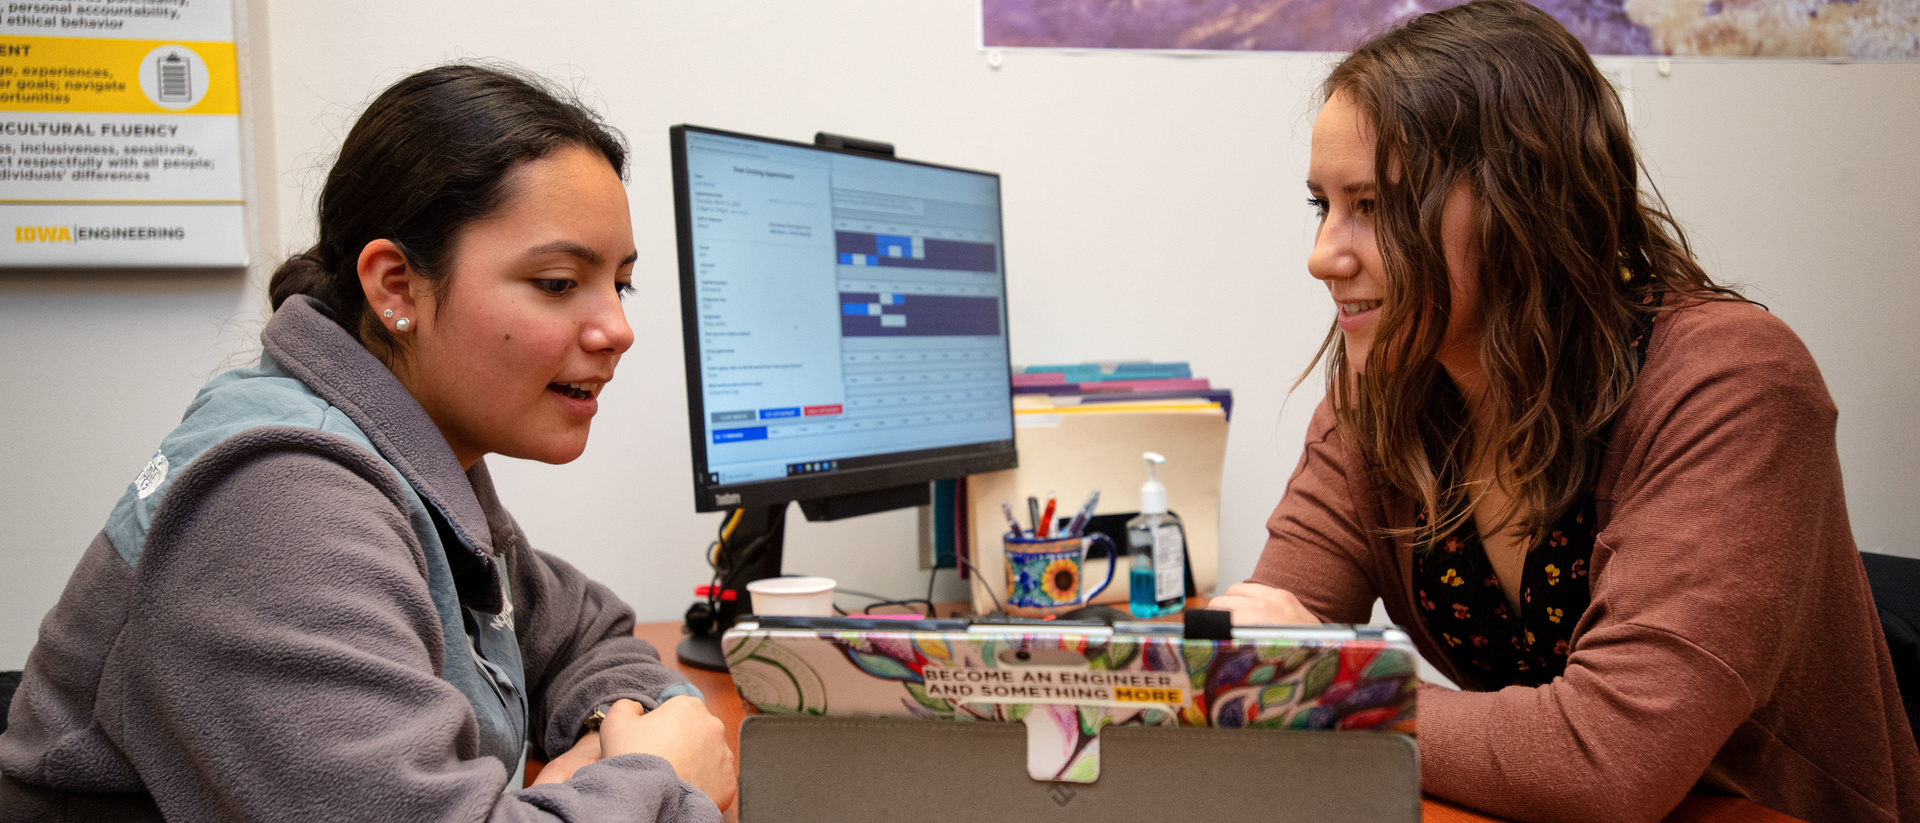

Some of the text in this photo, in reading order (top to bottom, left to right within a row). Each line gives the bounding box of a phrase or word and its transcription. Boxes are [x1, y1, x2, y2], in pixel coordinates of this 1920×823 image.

[9, 3, 181, 20] personal accountability,
[7, 14, 124, 30] ethical behavior
[0, 44, 31, 57] ENT
[22, 66, 113, 79] experiences,
[65, 80, 126, 93] navigate
[101, 123, 178, 138] FLUENCY
[21, 142, 119, 156] inclusiveness,
[123, 143, 197, 158] sensitivity,
[18, 157, 103, 171] respectfully
[108, 158, 138, 169] with
[142, 158, 158, 169] all
[72, 169, 150, 182] differences
[15, 226, 185, 243] IOWA ENGINEERING
[926, 669, 1013, 683] BECOME
[1022, 671, 1052, 684] AN
[929, 684, 1179, 701] AND SOMETHING MORE
